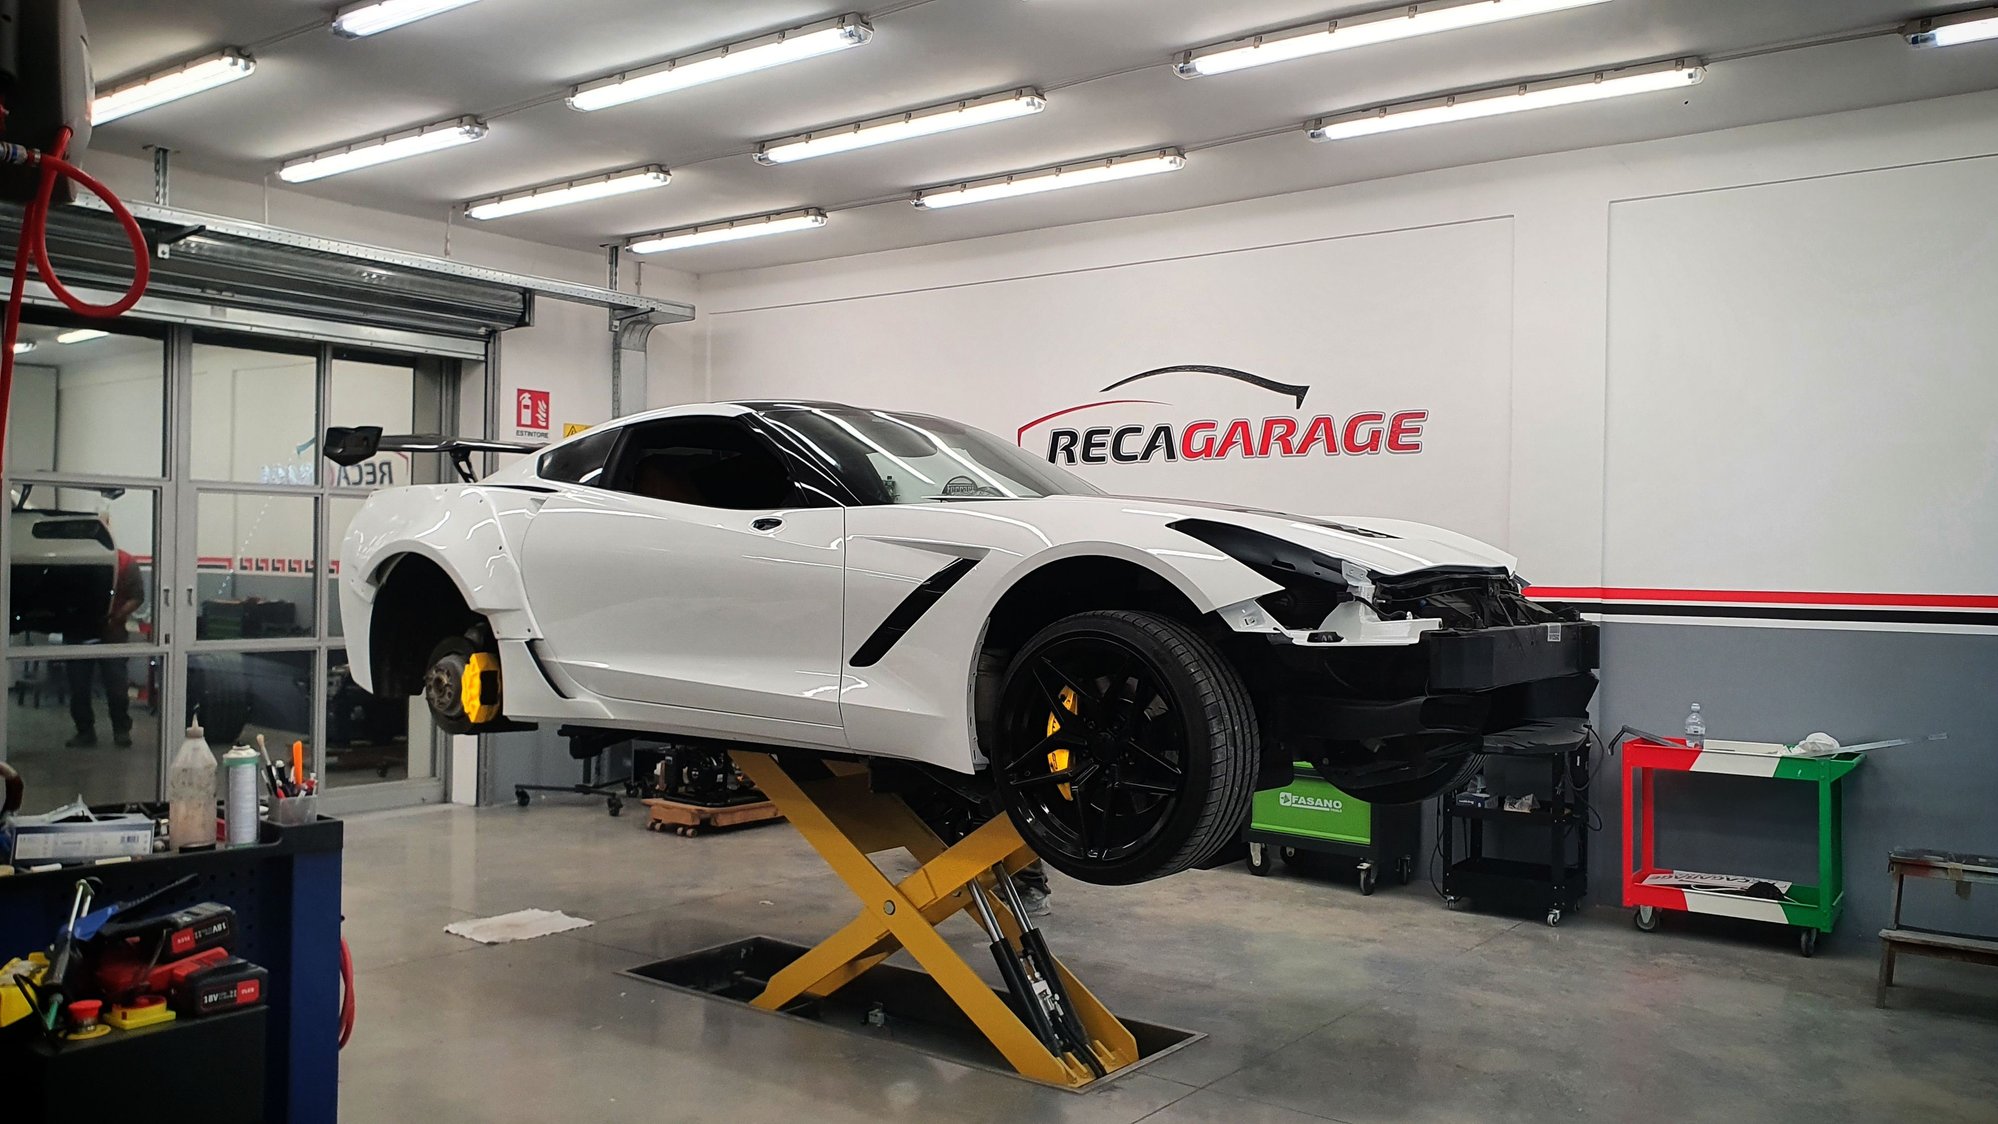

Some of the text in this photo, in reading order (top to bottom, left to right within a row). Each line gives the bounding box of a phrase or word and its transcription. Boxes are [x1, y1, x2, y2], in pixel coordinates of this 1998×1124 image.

[516, 430, 549, 438] ESTINTORE
[1046, 409, 1430, 466] RECAGARAGE
[1291, 795, 1343, 809] FASANO
[212, 922, 227, 934] 18V
[203, 993, 219, 1004] 18V
